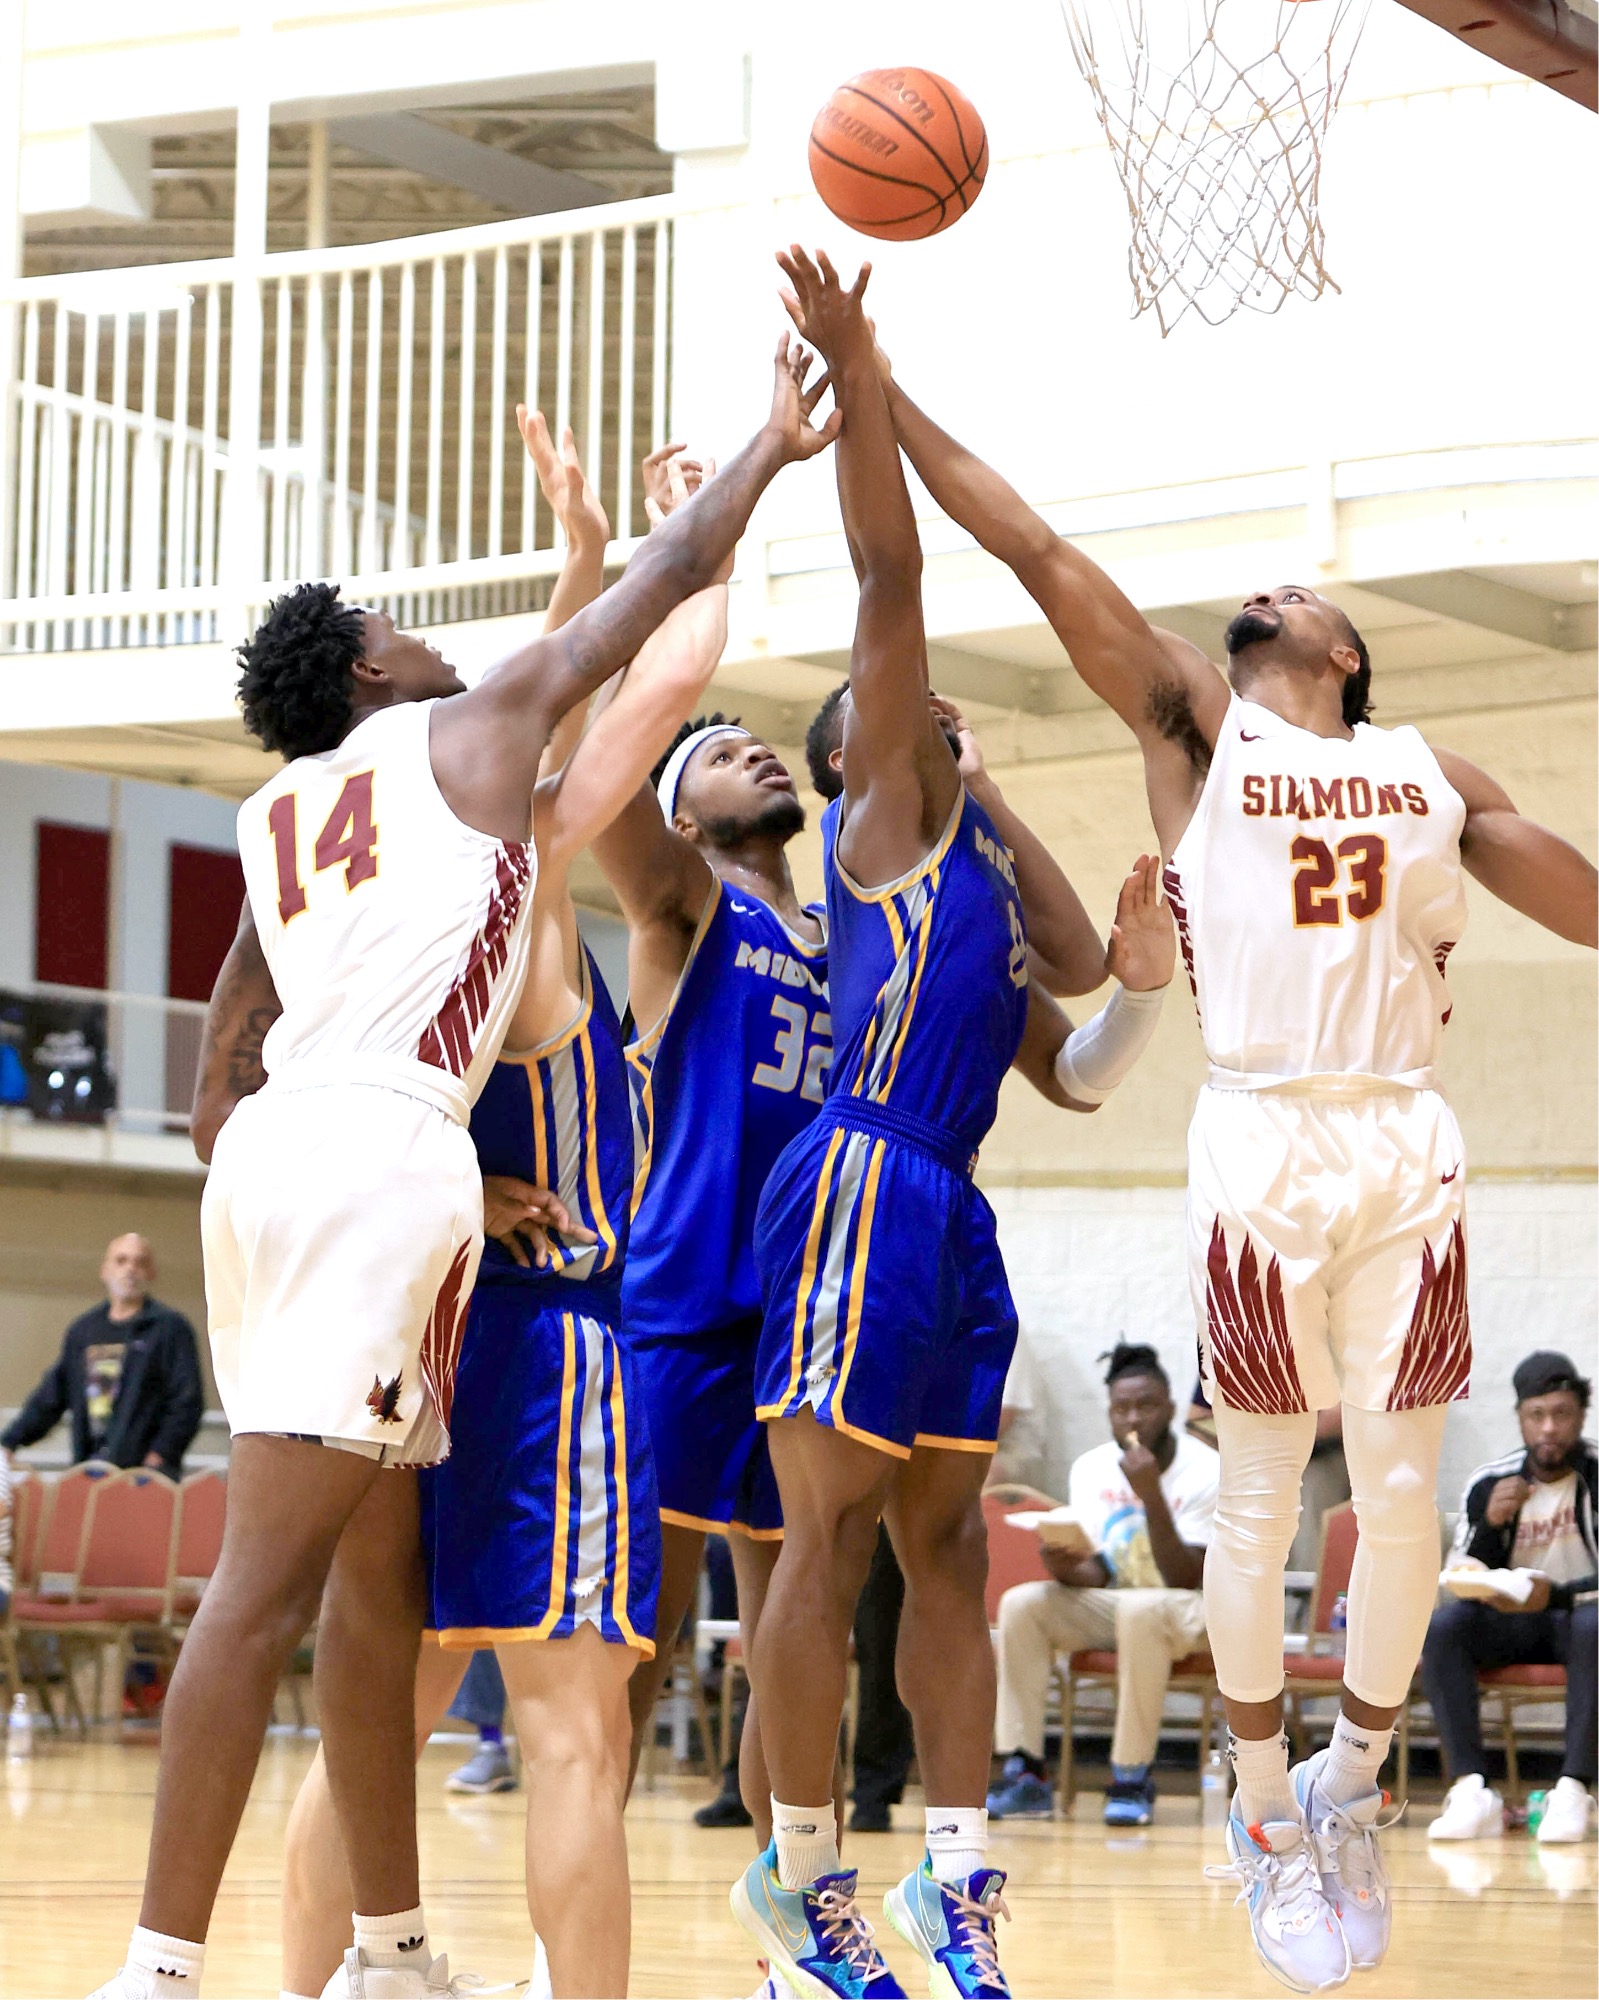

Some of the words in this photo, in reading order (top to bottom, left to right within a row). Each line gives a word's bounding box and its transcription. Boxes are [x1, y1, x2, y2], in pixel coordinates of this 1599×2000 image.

[1242, 774, 1430, 821] SIMMONS
[266, 765, 381, 930] 14
[1289, 832, 1389, 929] 23
